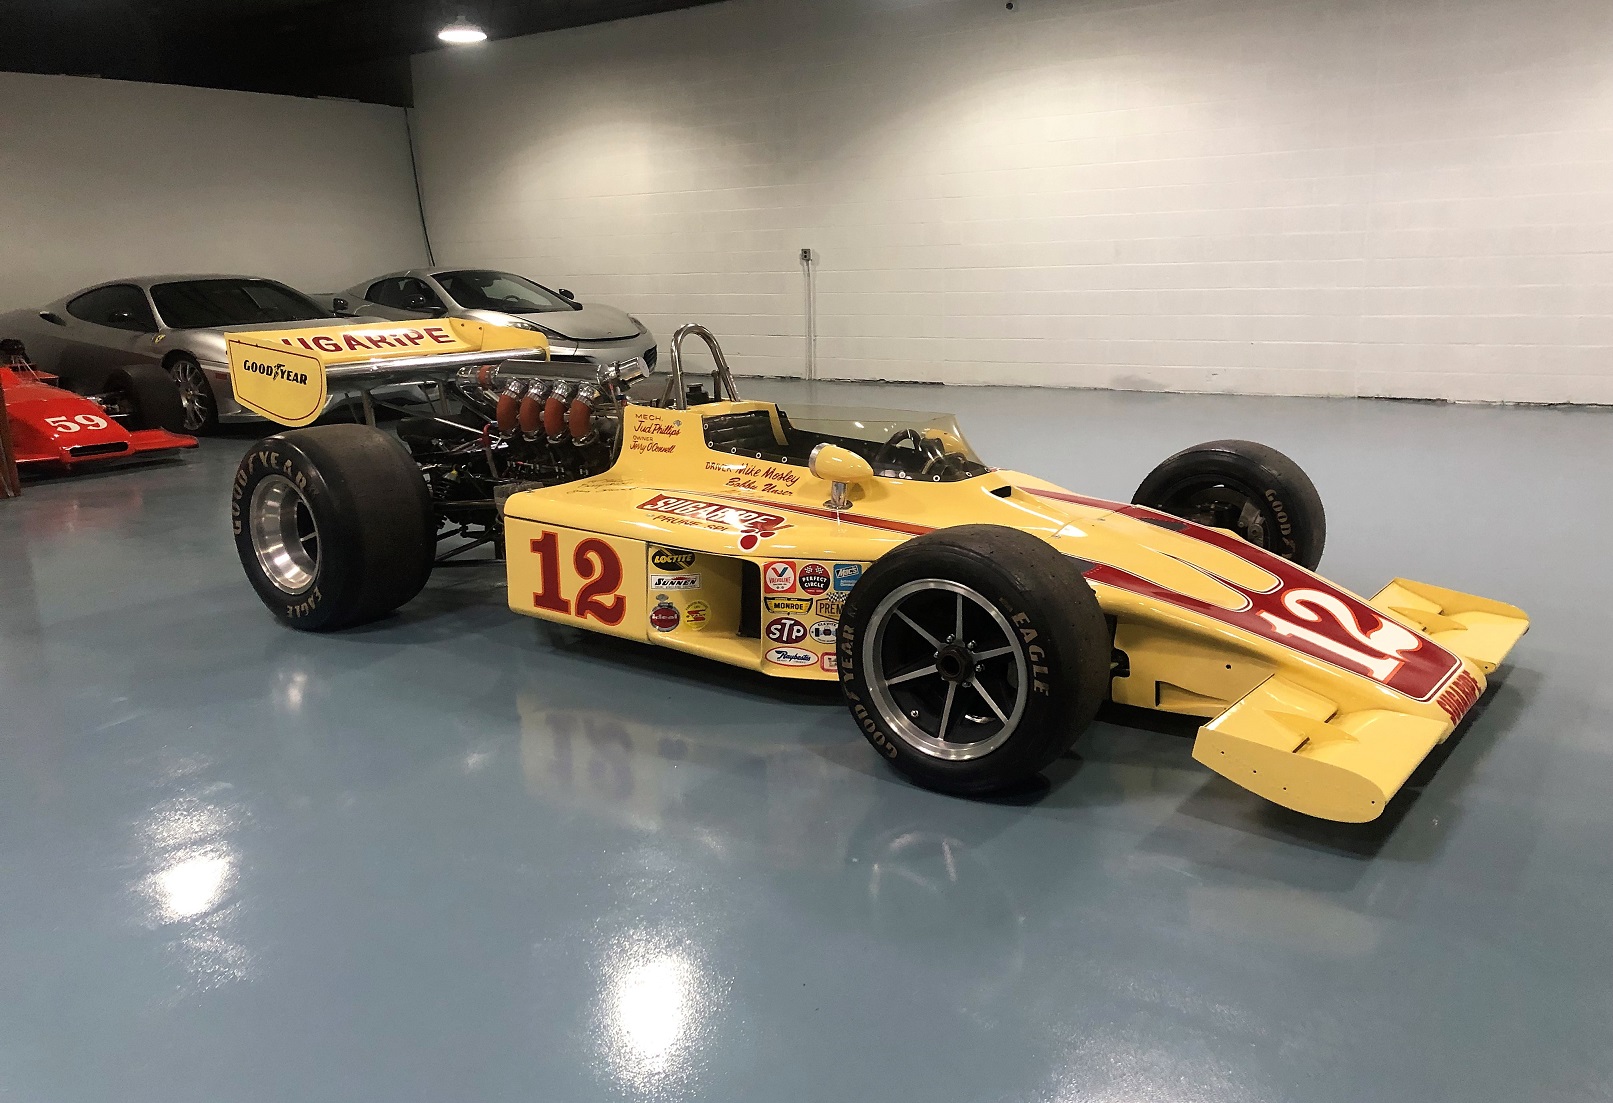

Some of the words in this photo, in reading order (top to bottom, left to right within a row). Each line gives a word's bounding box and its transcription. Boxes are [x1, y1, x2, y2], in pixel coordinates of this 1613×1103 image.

[243, 360, 308, 386] GOODYEAR
[44, 414, 108, 433] 59
[633, 420, 654, 434] Jud
[651, 423, 681, 438] Phillips
[733, 462, 762, 478] Mike
[761, 466, 801, 488] Mosley
[653, 553, 693, 563] LOCTITE
[530, 529, 627, 627] 12
[801, 575, 828, 583] PERFECT
[286, 586, 323, 618] EAGLE
[773, 602, 804, 611] MONROE
[819, 602, 843, 615] PREM
[769, 619, 804, 641] STP
[1256, 587, 1424, 685] 12
[1011, 612, 1050, 697] EAGLE
